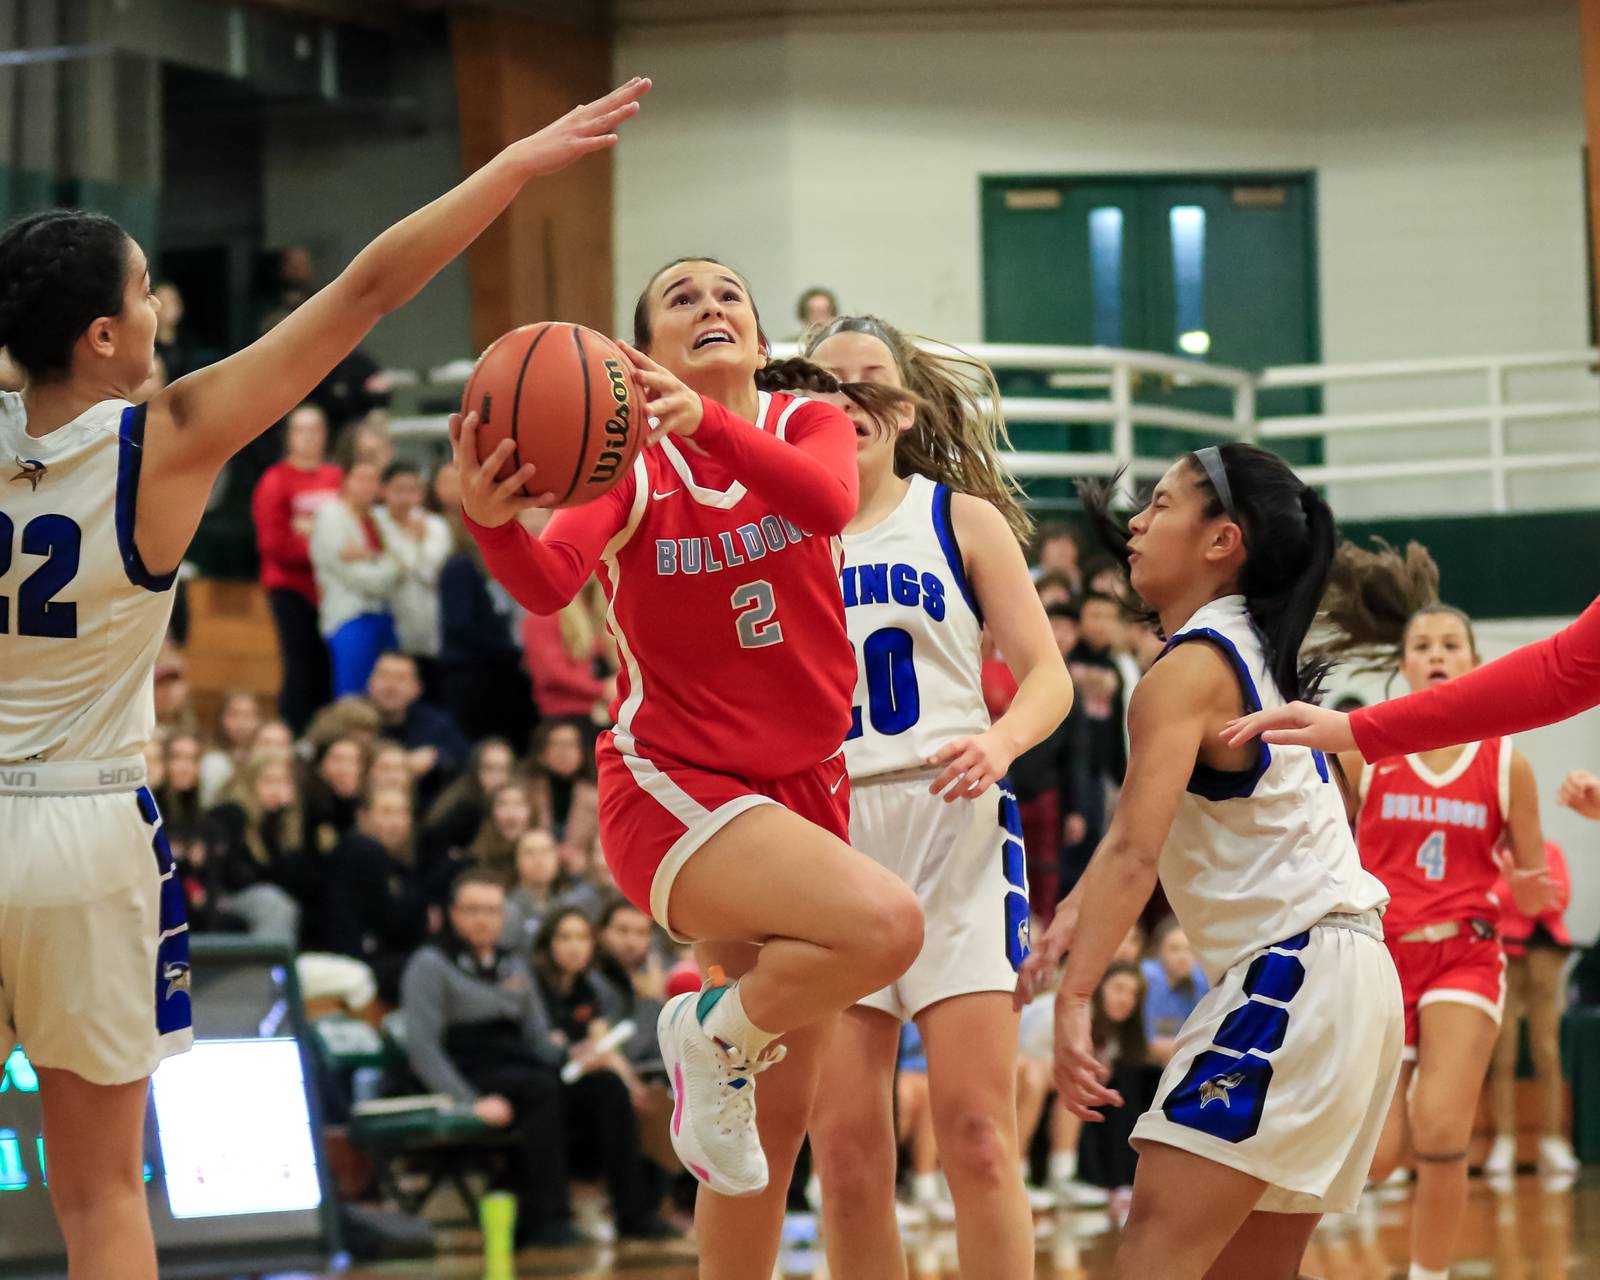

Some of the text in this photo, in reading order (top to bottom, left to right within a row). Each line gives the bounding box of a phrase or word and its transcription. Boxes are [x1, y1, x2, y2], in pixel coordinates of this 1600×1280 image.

[587, 358, 630, 484] Wilson
[0, 511, 82, 638] 2
[656, 515, 813, 576] BULLDOG
[730, 579, 784, 649] 2
[845, 627, 920, 741] 0
[1382, 793, 1487, 829] BULLDOGS
[1415, 830, 1446, 880] 4
